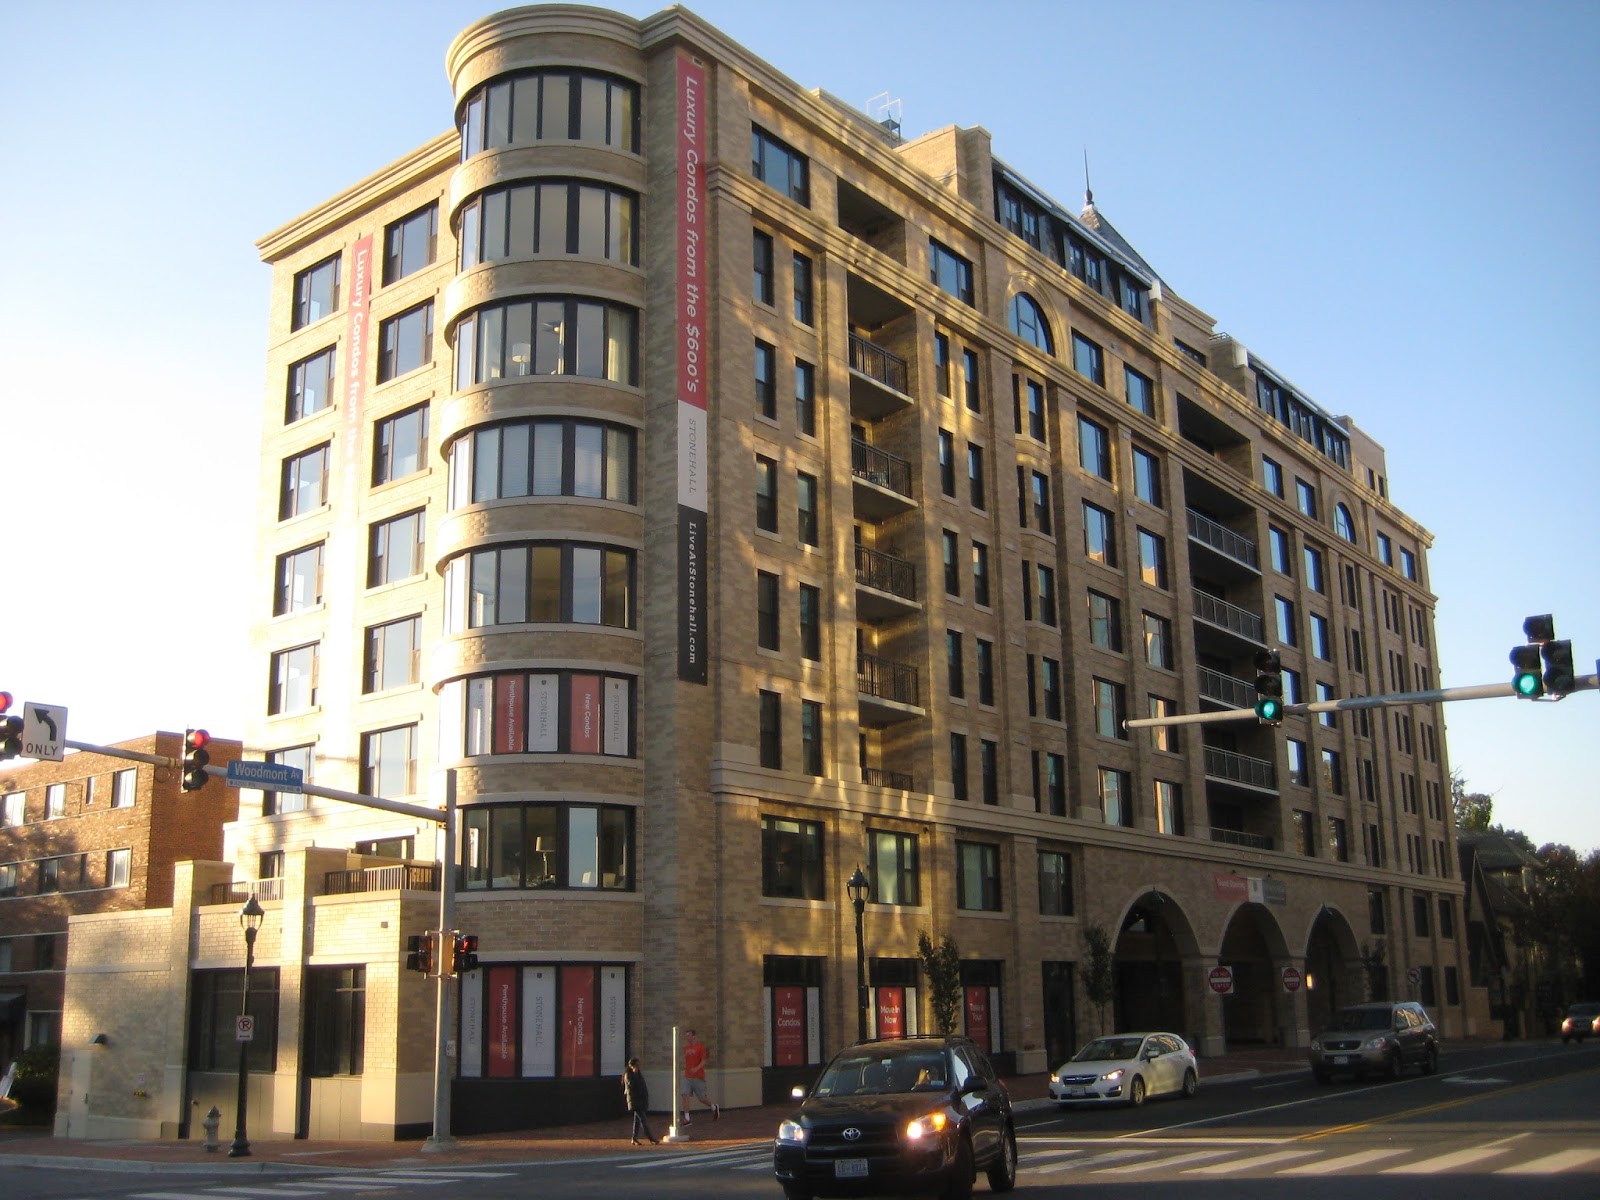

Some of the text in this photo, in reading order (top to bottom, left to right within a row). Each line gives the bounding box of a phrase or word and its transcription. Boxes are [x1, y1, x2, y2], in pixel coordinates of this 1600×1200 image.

[683, 76, 700, 393] Luxury Condos from the $600's
[352, 250, 367, 307] Luxury
[350, 313, 363, 378] Condos
[348, 381, 361, 424] from
[688, 418, 697, 494] STONEHALL
[688, 521, 697, 664] LiveAtStonehall.com
[540, 690, 548, 739] STONEHALL
[584, 711, 592, 738] Condos
[26, 743, 58, 756] ONLY
[235, 763, 300, 780] Woodmont Av
[535, 995, 544, 1047] STONEHALL
[577, 1016, 585, 1045] Condos
[777, 1018, 801, 1027] Condos
[781, 1006, 796, 1016] New
[884, 1015, 897, 1024] Now
